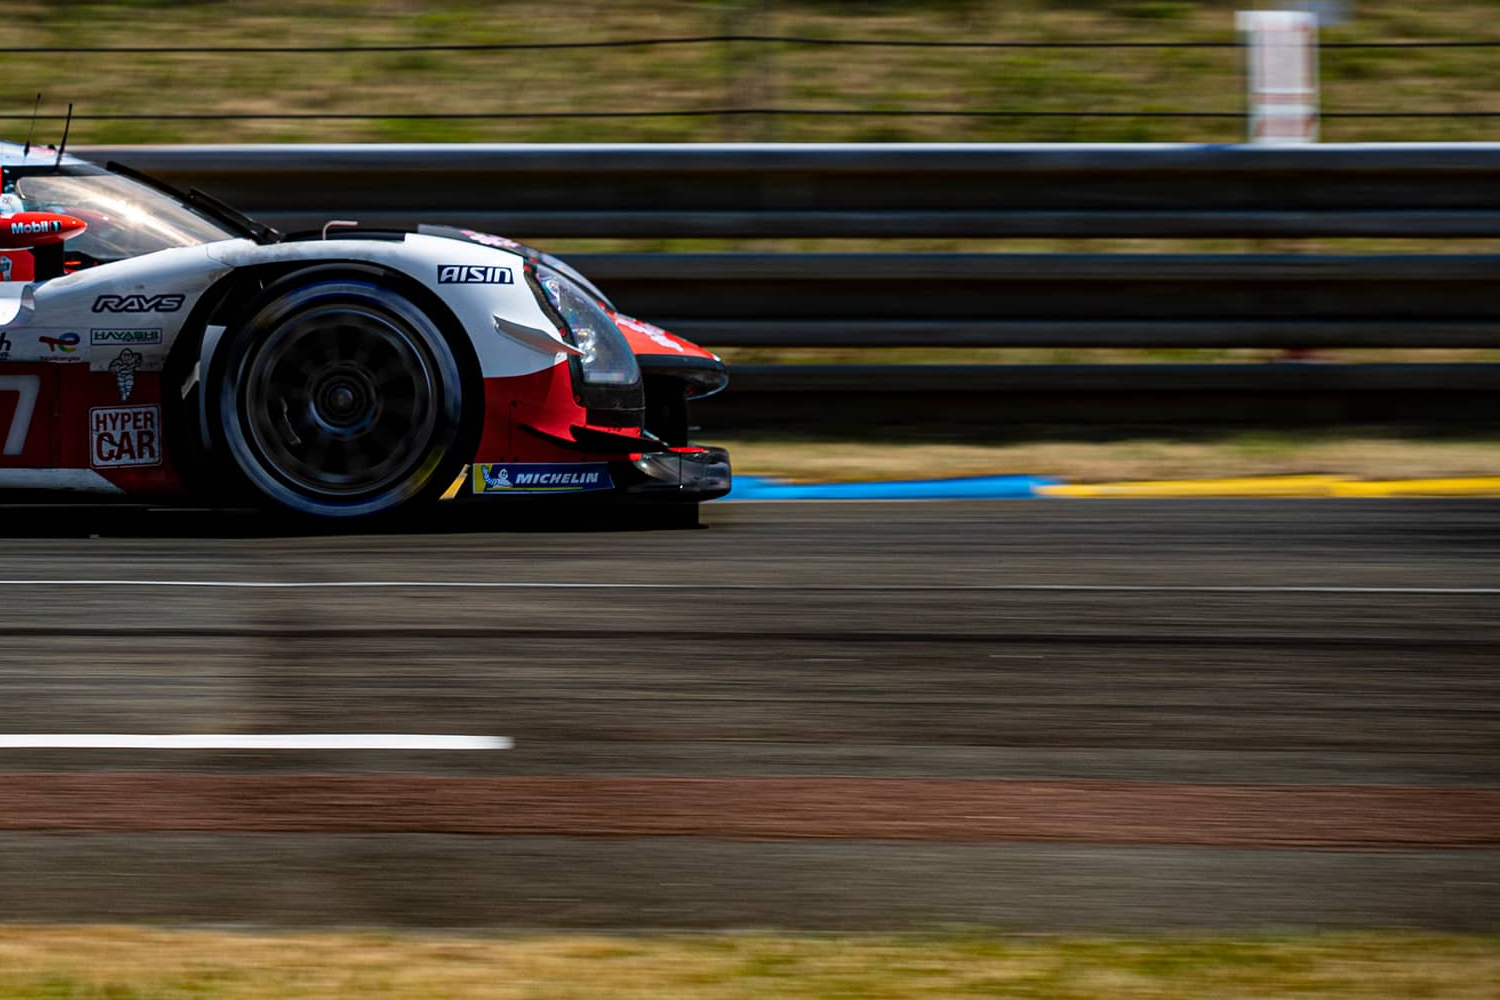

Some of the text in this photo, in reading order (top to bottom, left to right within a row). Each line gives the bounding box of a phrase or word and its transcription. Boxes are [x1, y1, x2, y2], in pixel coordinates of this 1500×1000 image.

[11, 220, 49, 235] Mobil
[439, 266, 511, 283] AISIN
[92, 294, 186, 313] RAYS
[94, 331, 159, 340] HAYASHI
[96, 411, 155, 431] HYPER
[96, 431, 155, 462] CAR
[515, 472, 599, 484] MICHELIN
